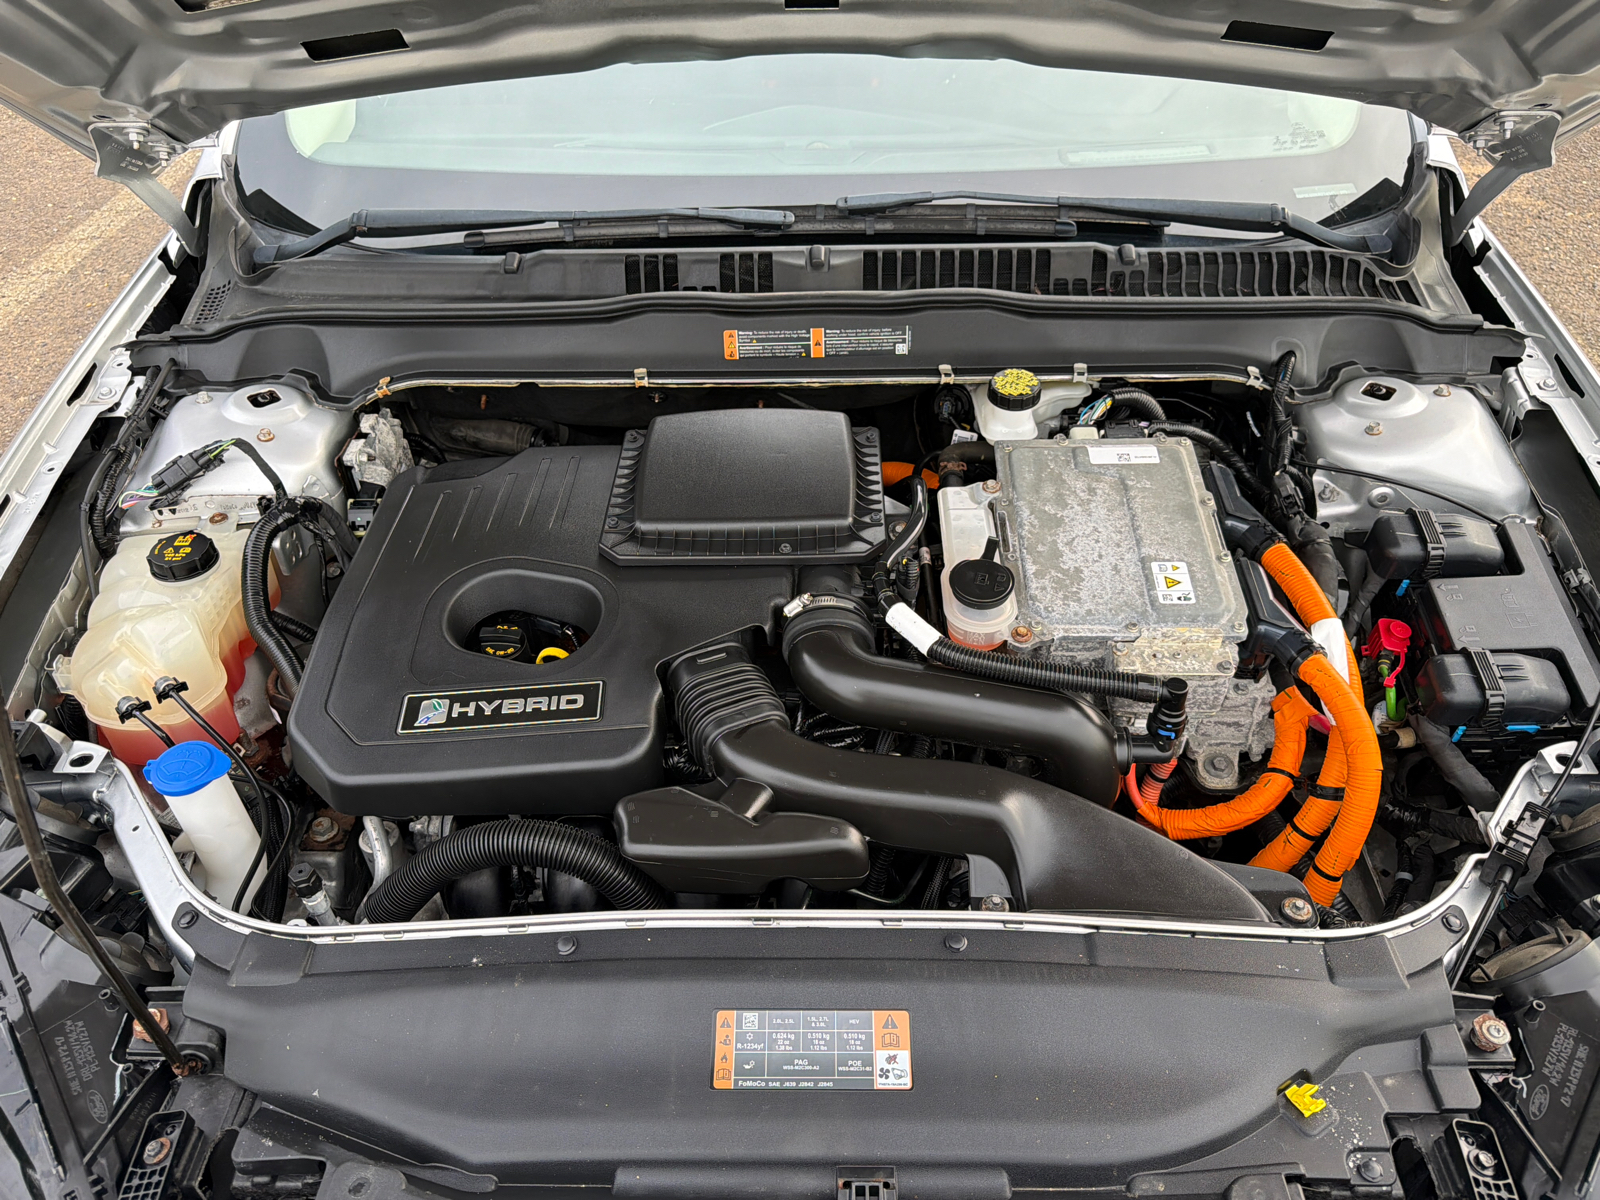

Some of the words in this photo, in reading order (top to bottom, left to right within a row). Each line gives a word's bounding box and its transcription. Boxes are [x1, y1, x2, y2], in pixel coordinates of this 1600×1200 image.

[452, 694, 584, 718] HYBRID
[788, 1032, 795, 1040] kg
[823, 1032, 830, 1040] kg
[859, 1032, 866, 1040] kg
[737, 1042, 764, 1051] R-1234yf
